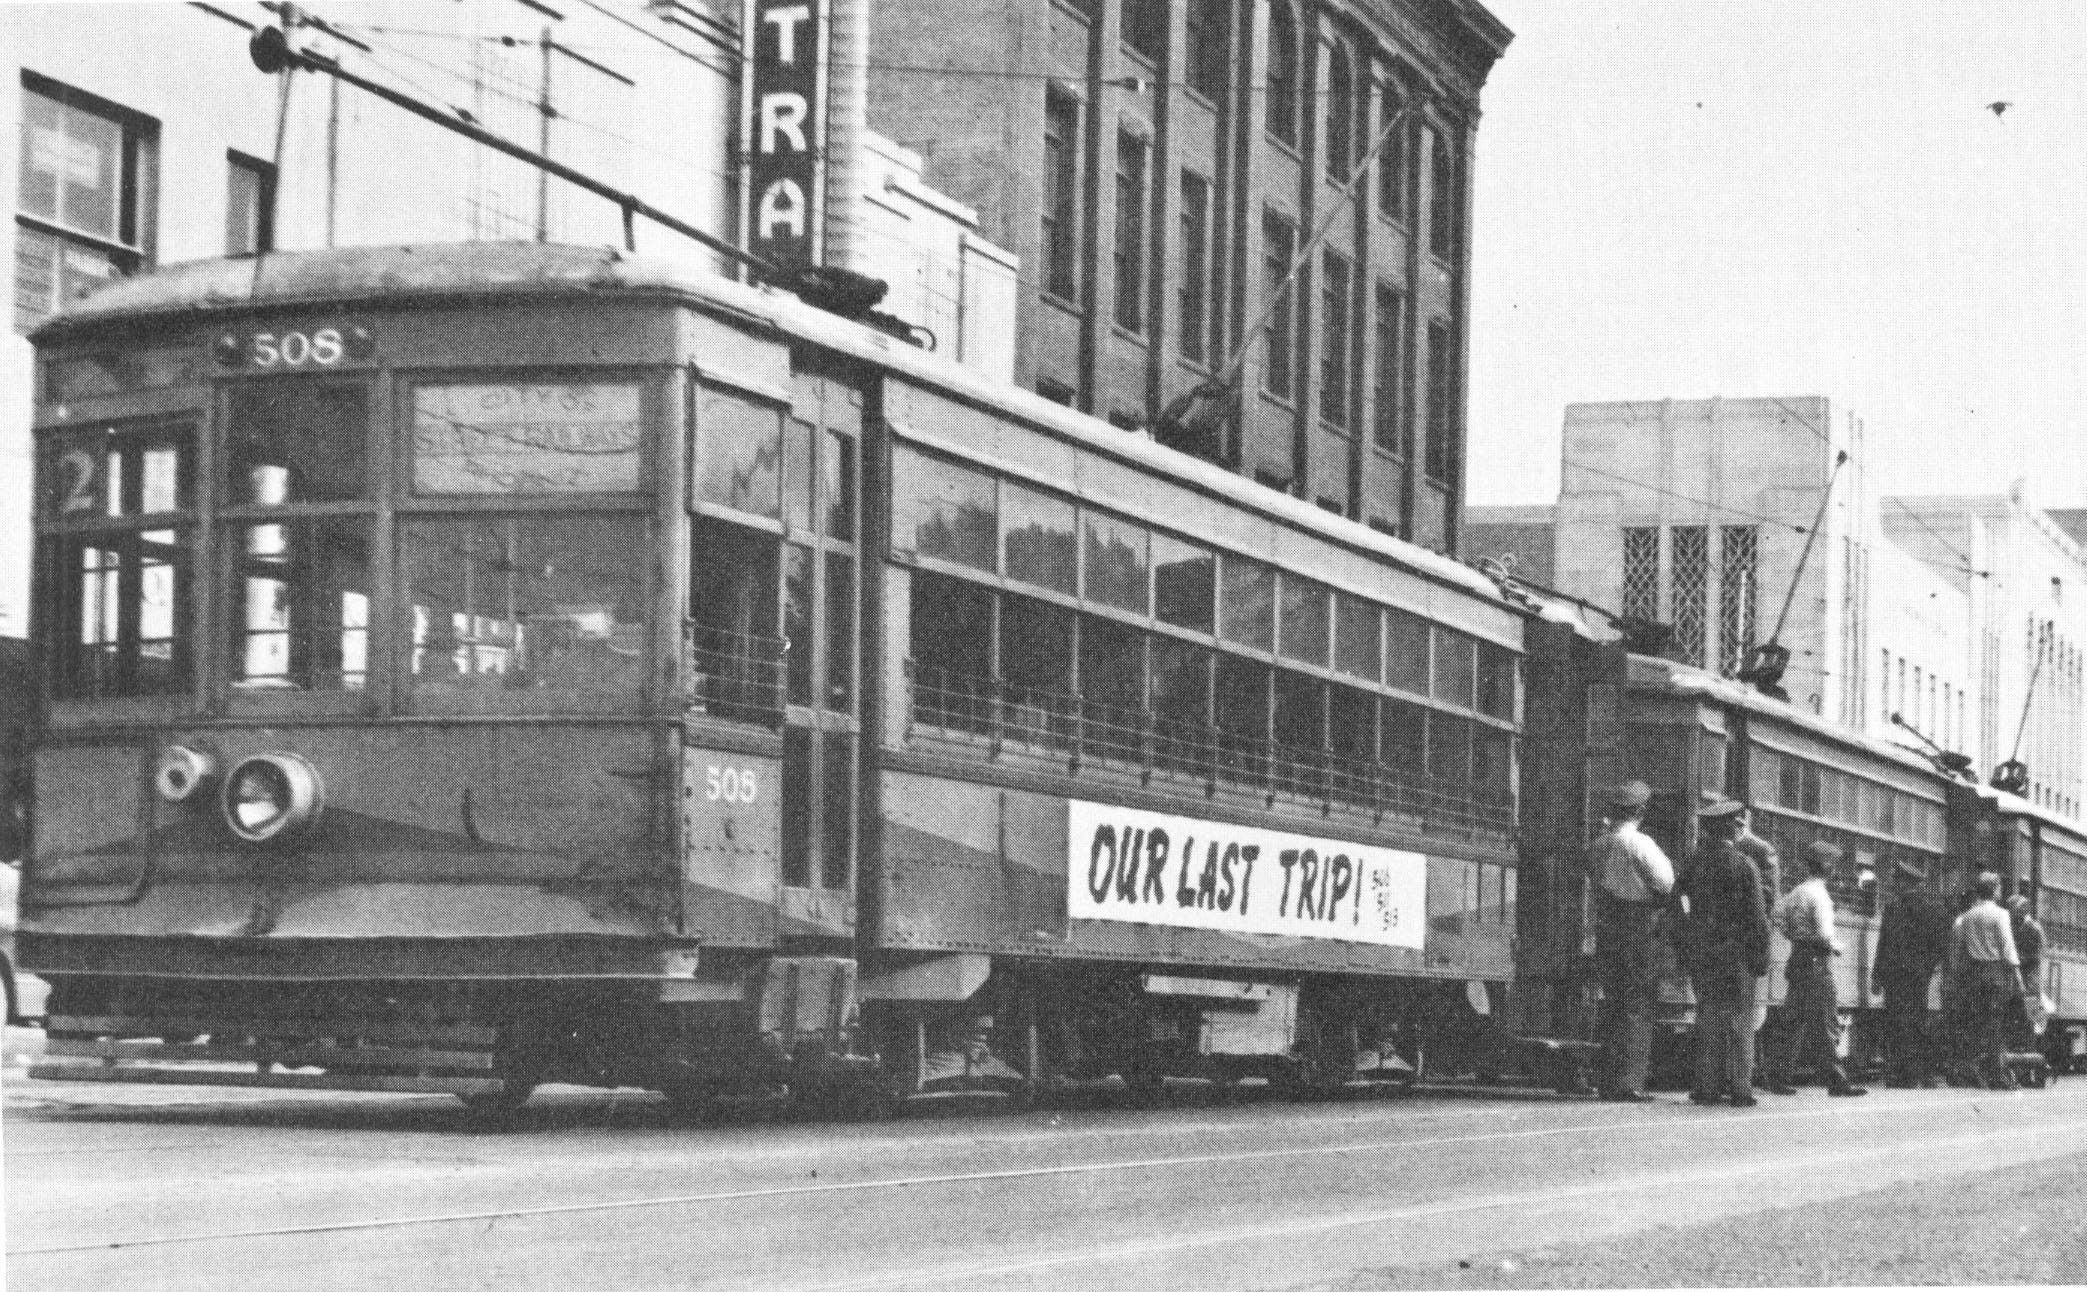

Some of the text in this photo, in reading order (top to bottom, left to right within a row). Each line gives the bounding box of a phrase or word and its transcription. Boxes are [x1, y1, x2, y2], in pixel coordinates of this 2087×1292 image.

[255, 328, 342, 366] 508
[58, 450, 94, 513] 2
[706, 765, 757, 804] 508
[1088, 823, 1363, 926] OUR LAST TRIP!
